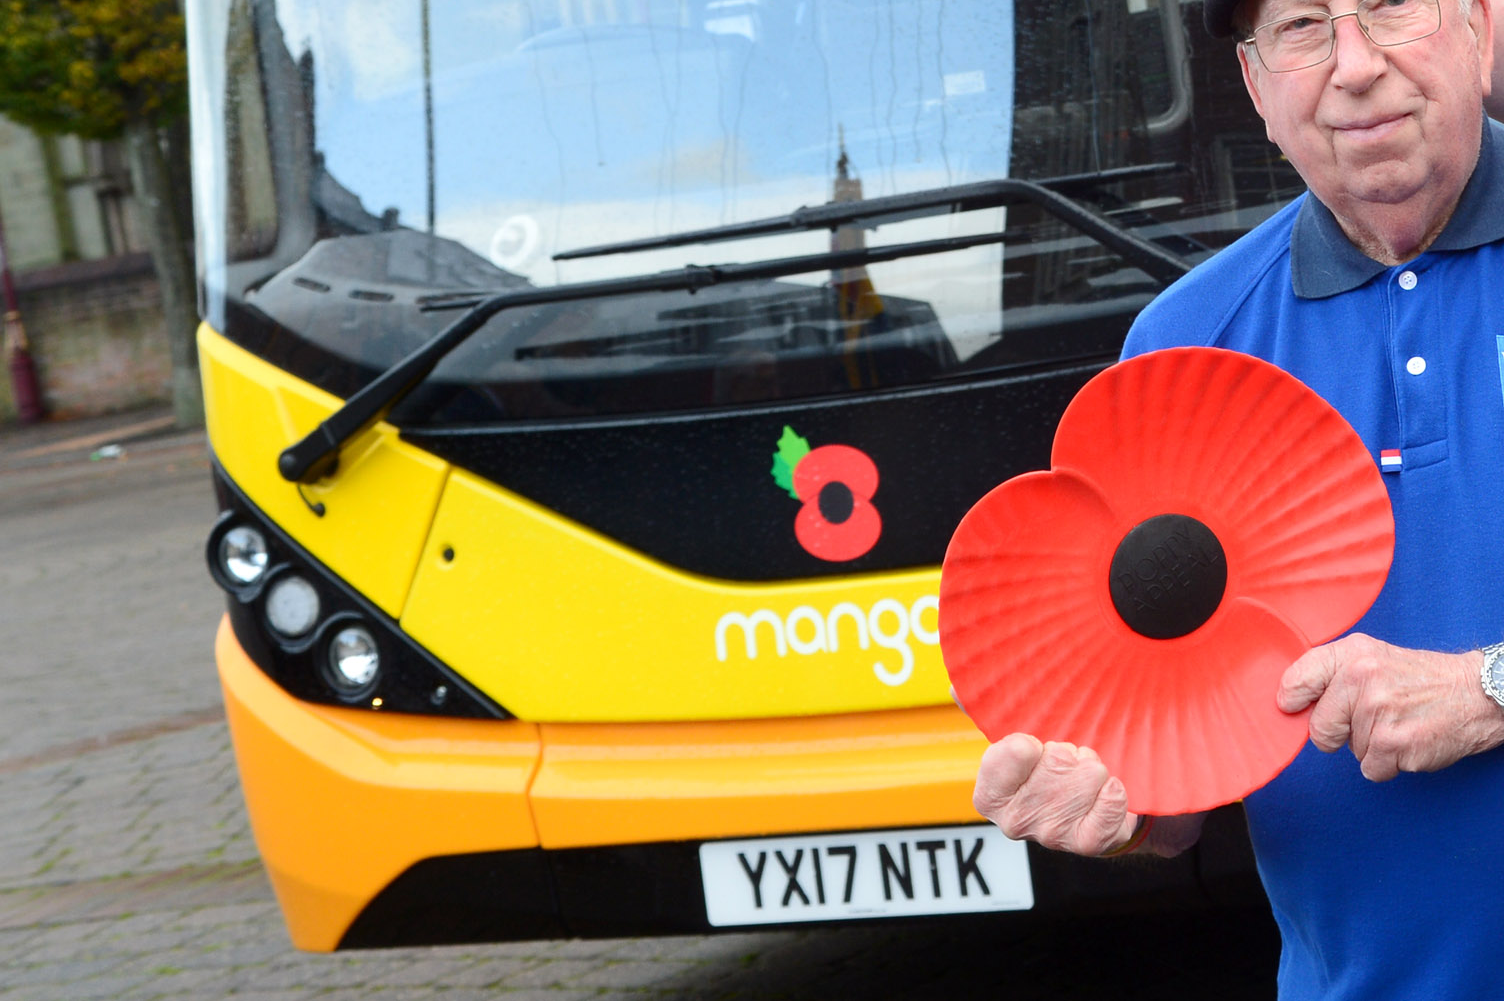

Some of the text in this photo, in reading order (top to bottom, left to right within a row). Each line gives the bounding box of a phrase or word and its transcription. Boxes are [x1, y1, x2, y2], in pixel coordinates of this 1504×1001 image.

[1118, 522, 1191, 593] POPPY
[1134, 547, 1220, 612] APPEAL
[714, 595, 940, 686] mango
[737, 837, 991, 909] YX17 NTK
